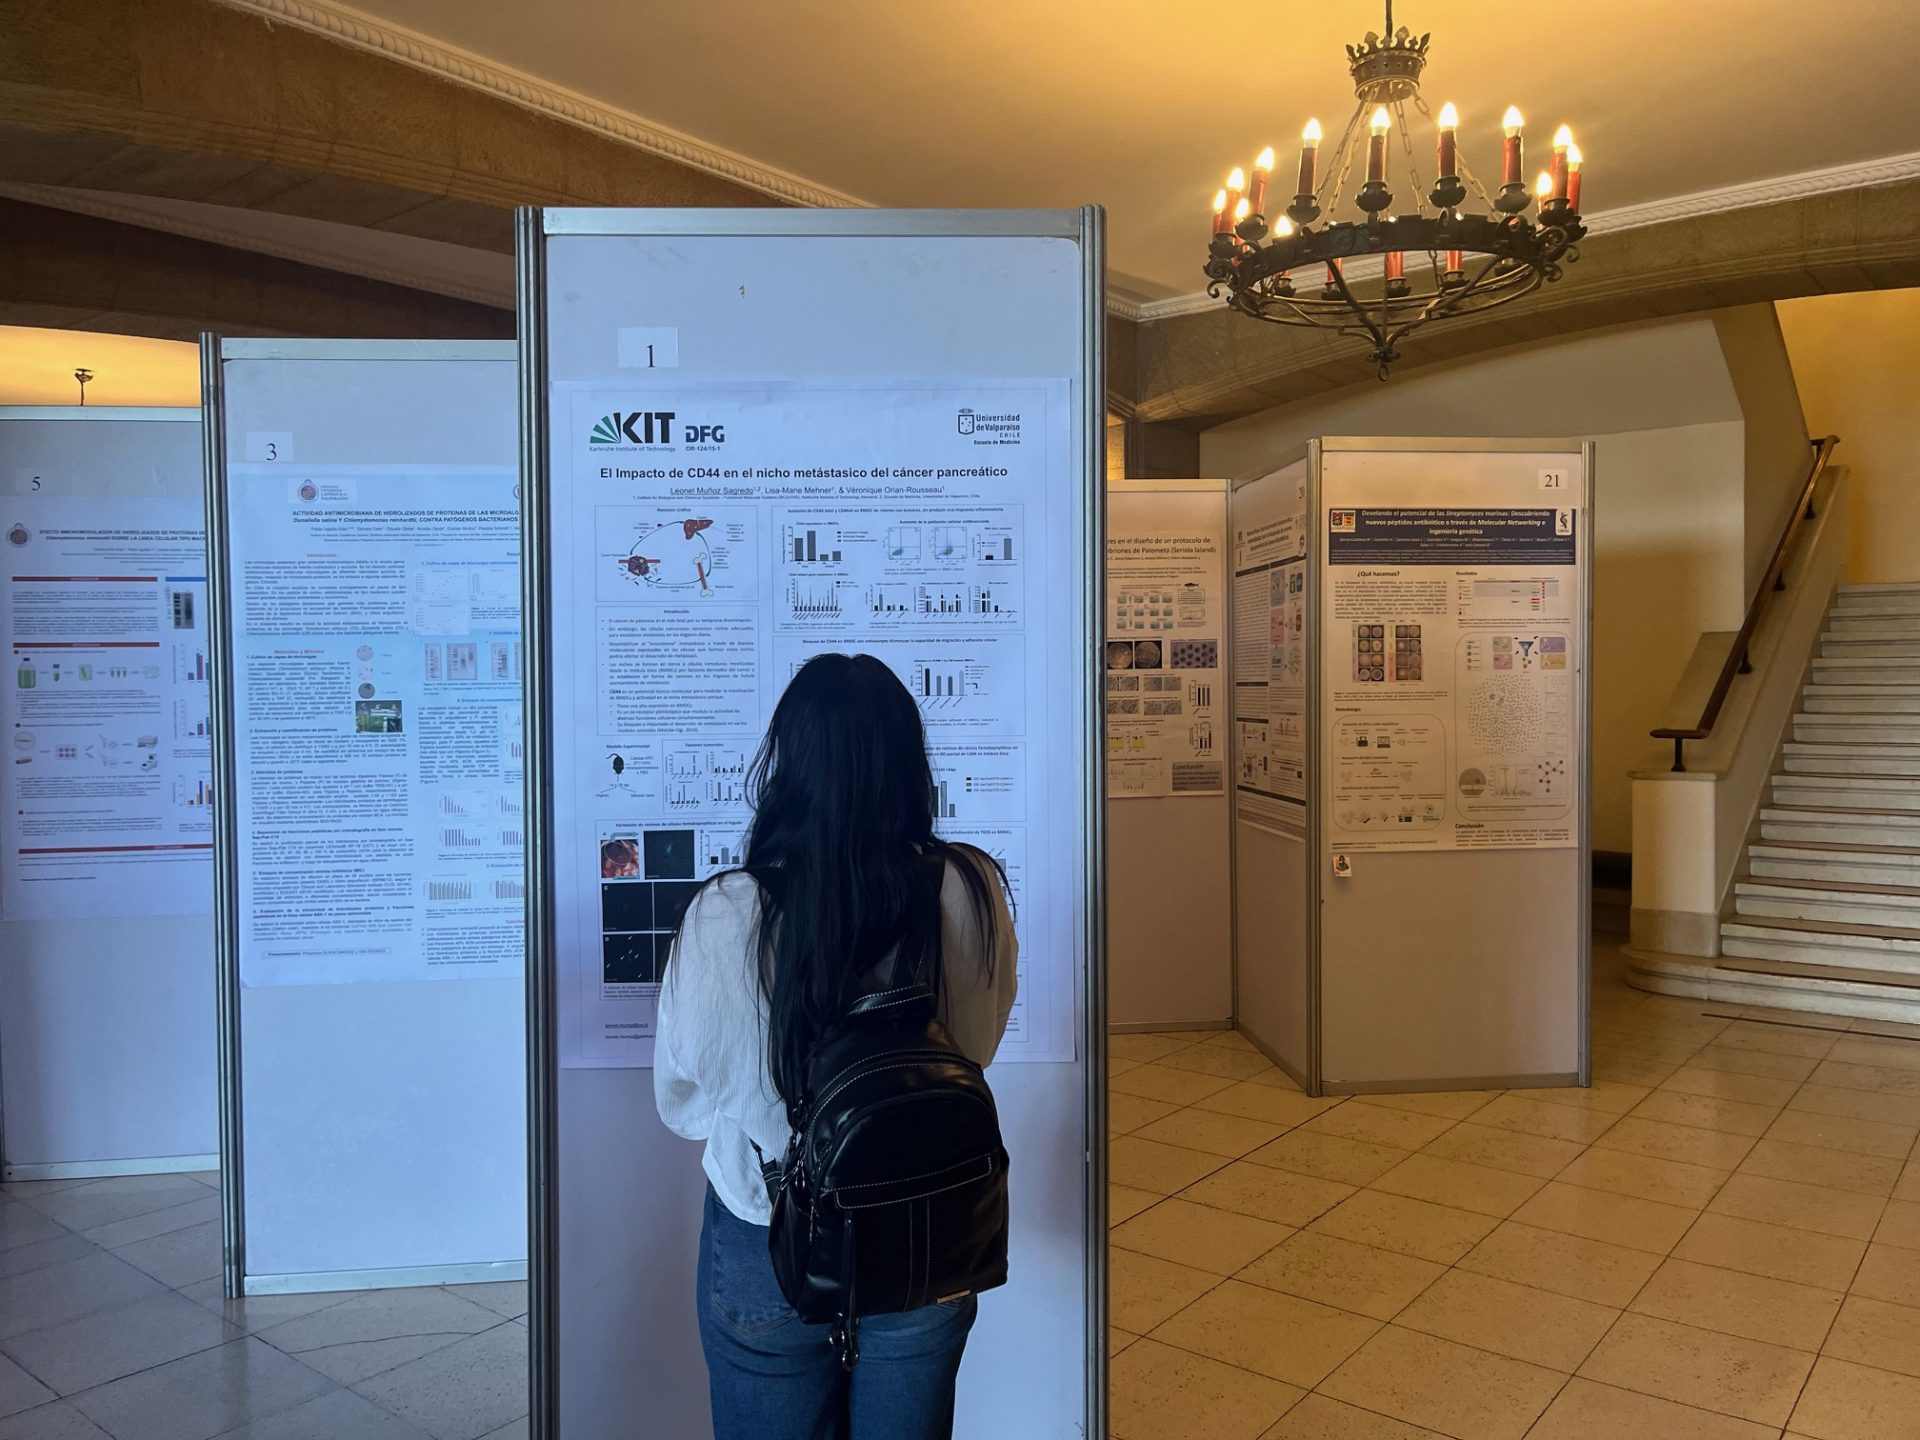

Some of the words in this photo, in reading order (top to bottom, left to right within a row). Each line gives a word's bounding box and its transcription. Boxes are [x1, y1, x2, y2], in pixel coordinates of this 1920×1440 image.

[646, 344, 655, 368] 1
[612, 412, 675, 443] KIT
[686, 426, 724, 442] DFG
[267, 444, 276, 460] 3
[601, 468, 612, 478] El
[616, 468, 665, 480] Impacto
[669, 468, 683, 478] de
[688, 468, 719, 478] CD44
[724, 470, 738, 478] en
[743, 468, 752, 478] el
[757, 468, 790, 478] nicho
[794, 468, 867, 478] metástasico
[871, 467, 888, 477] del
[893, 467, 933, 477] cáncer
[937, 467, 1008, 479] pancreático
[1545, 475, 1558, 487] 21
[32, 477, 40, 490] 5
